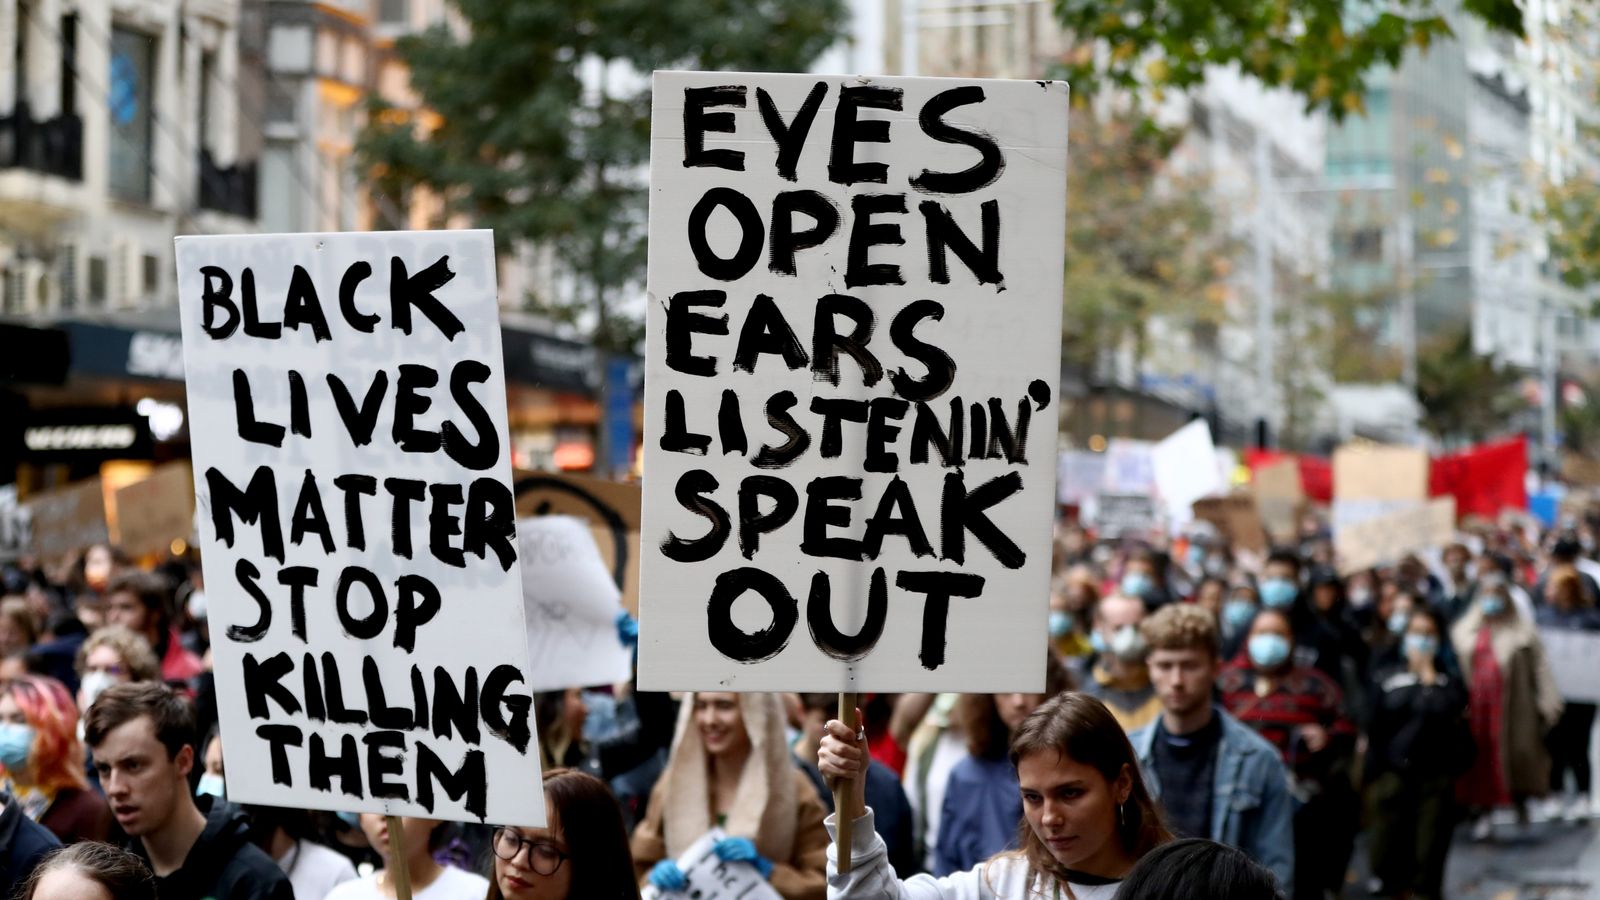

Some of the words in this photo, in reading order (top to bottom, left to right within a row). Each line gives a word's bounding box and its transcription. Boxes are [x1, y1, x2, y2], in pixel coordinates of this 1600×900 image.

[682, 81, 1007, 195] EYES
[687, 187, 1006, 293] OPEN
[200, 255, 466, 344] BLACK
[664, 289, 957, 402] EARS
[232, 359, 501, 471] LIVES
[660, 379, 1052, 473] LISTENIN'
[205, 465, 518, 573] MATTER
[660, 468, 1027, 570] SPEAK
[226, 558, 442, 655] STOP
[707, 566, 986, 672] OUT
[242, 651, 532, 756] KILLING
[256, 723, 488, 823] THEM
